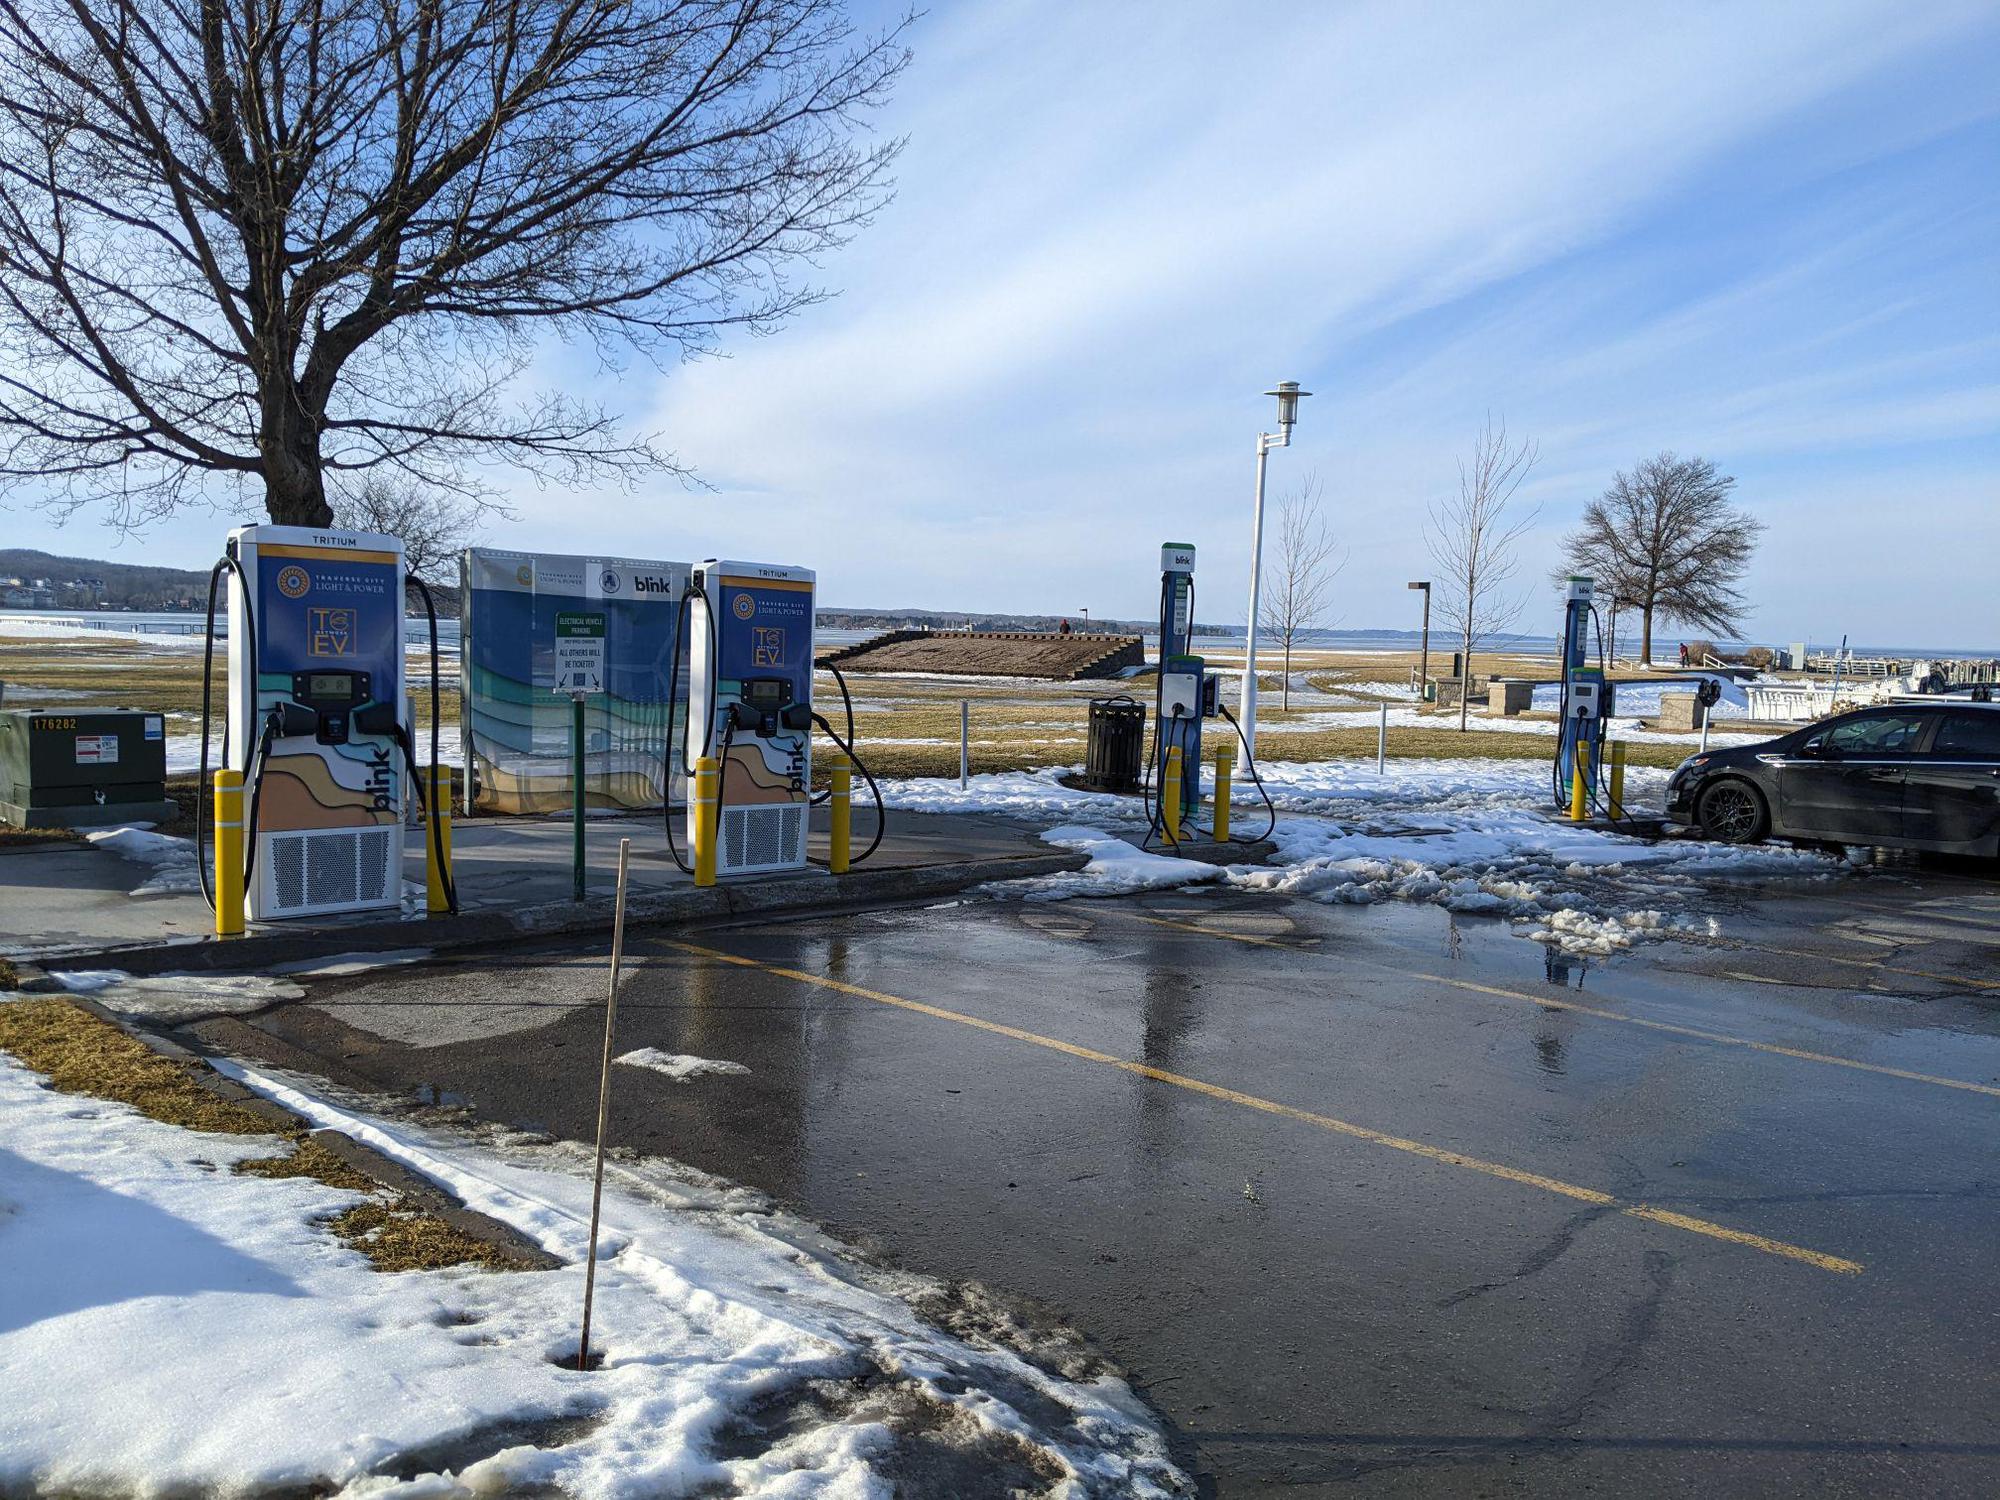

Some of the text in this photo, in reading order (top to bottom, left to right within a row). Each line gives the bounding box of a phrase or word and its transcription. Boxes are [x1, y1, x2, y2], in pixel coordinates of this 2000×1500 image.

[312, 535, 357, 546] TRITIUM
[1175, 555, 1190, 565] blink
[758, 569, 788, 578] TRITIUM
[315, 582, 385, 593] LIGHT & POWER
[634, 576, 671, 593] blink
[585, 617, 602, 625] VEHICLE
[314, 635, 349, 656] EV
[559, 649, 601, 657] ALL OTHERS WILL
[755, 649, 780, 665] EV
[565, 660, 595, 668] BE TICKETED
[34, 718, 76, 730] 176282
[786, 741, 804, 792] blink
[365, 748, 390, 813] blink
